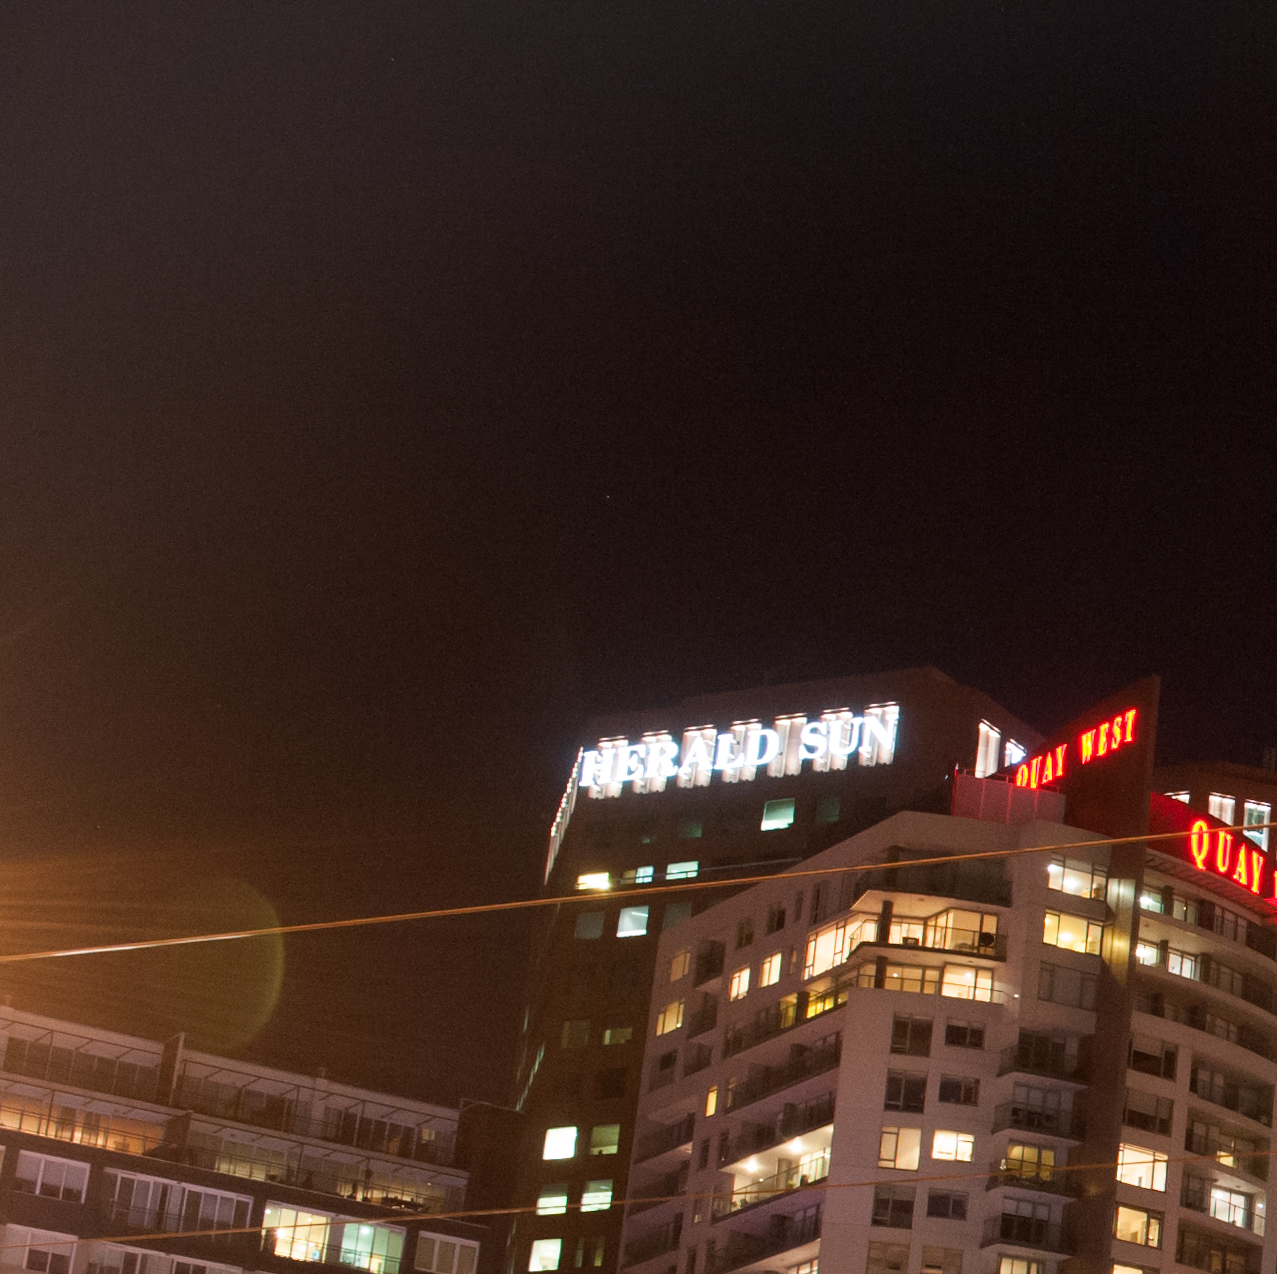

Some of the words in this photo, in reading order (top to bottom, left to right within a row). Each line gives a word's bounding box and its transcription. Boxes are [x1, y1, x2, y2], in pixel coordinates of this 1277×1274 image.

[579, 729, 781, 788] HERALD
[799, 714, 899, 760] SUN
[1016, 744, 1068, 789] QUAY
[1081, 709, 1137, 764] WEST
[1191, 820, 1265, 894] QUAY
